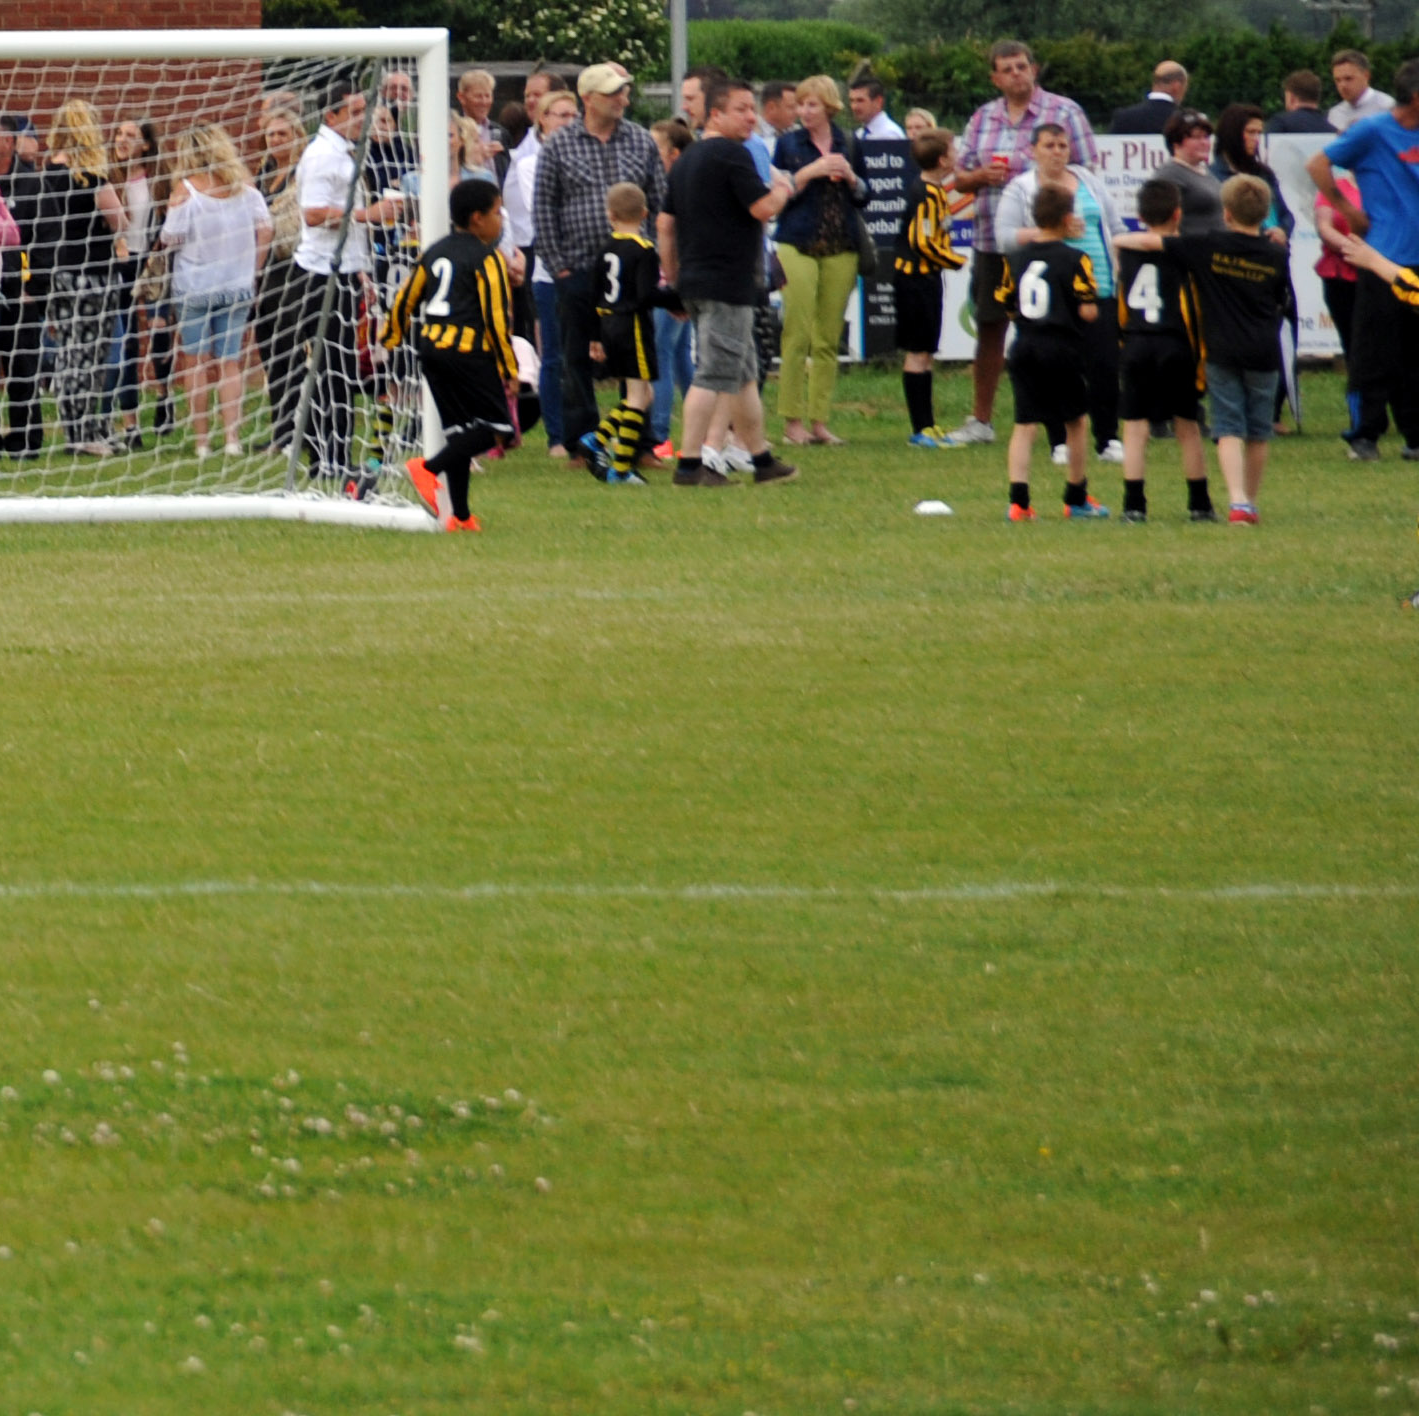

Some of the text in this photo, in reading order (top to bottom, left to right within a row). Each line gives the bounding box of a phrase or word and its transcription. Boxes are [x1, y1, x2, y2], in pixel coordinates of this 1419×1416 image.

[889, 154, 904, 168] to
[426, 257, 453, 316] 2
[604, 252, 620, 303] 3
[1019, 260, 1050, 319] 6
[1127, 263, 1162, 323] 4
